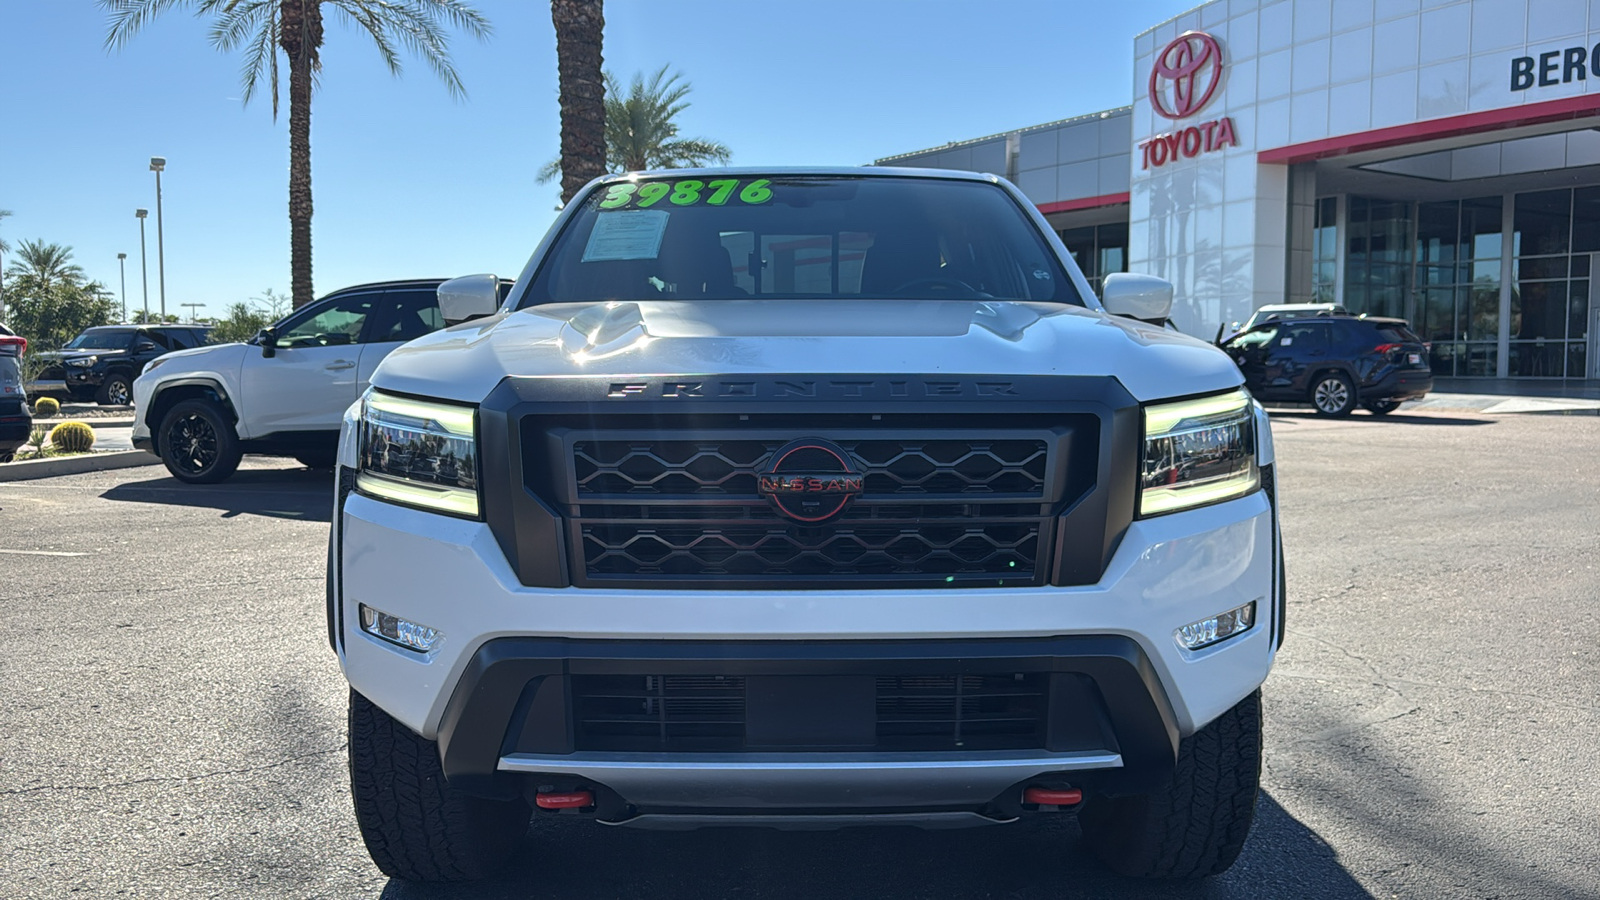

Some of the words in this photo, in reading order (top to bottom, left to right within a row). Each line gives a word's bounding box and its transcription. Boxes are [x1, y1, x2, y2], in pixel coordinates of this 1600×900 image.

[1138, 117, 1237, 170] TOYOTA
[600, 179, 773, 208] 39876
[608, 382, 1019, 397] FRONTIER
[761, 477, 861, 491] NISSAN
